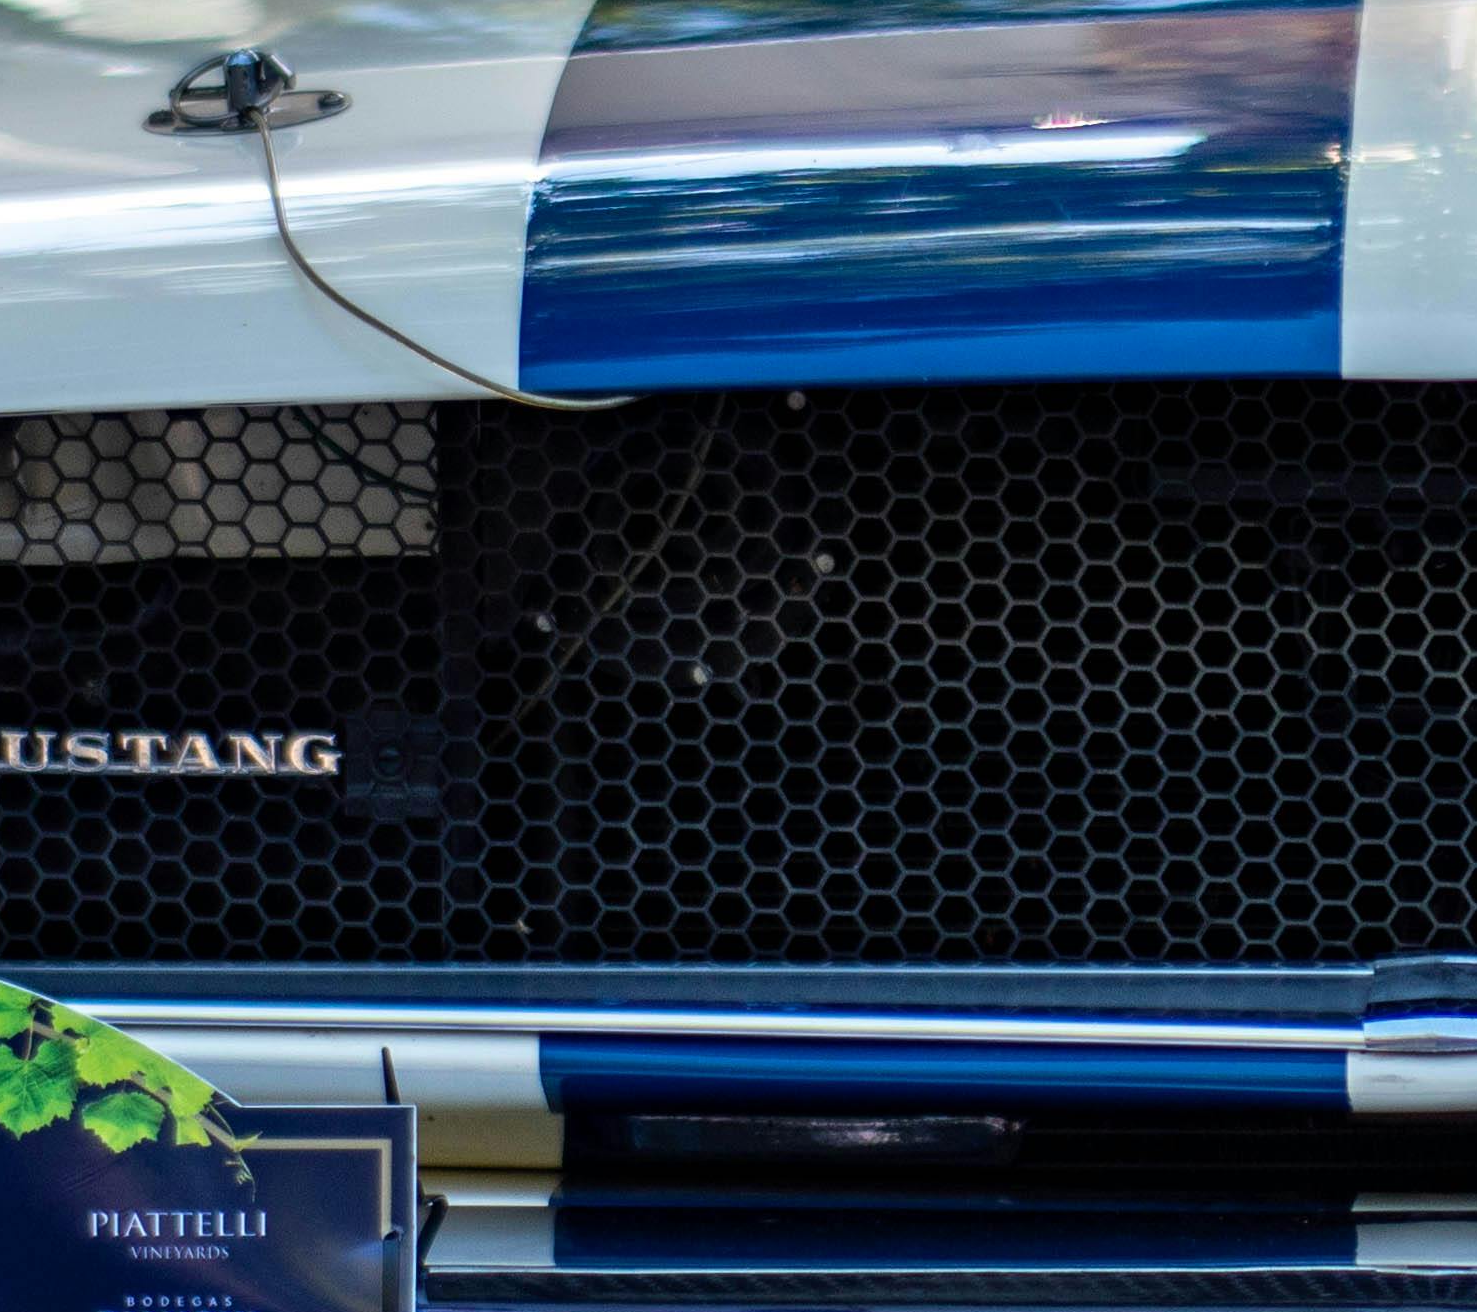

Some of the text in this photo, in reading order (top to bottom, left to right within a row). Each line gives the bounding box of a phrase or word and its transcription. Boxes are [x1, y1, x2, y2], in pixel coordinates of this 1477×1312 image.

[90, 1211, 267, 1238] PIATTELLI
[130, 1245, 230, 1261] VINEYARDS
[125, 1295, 233, 1308] BODEGAS
